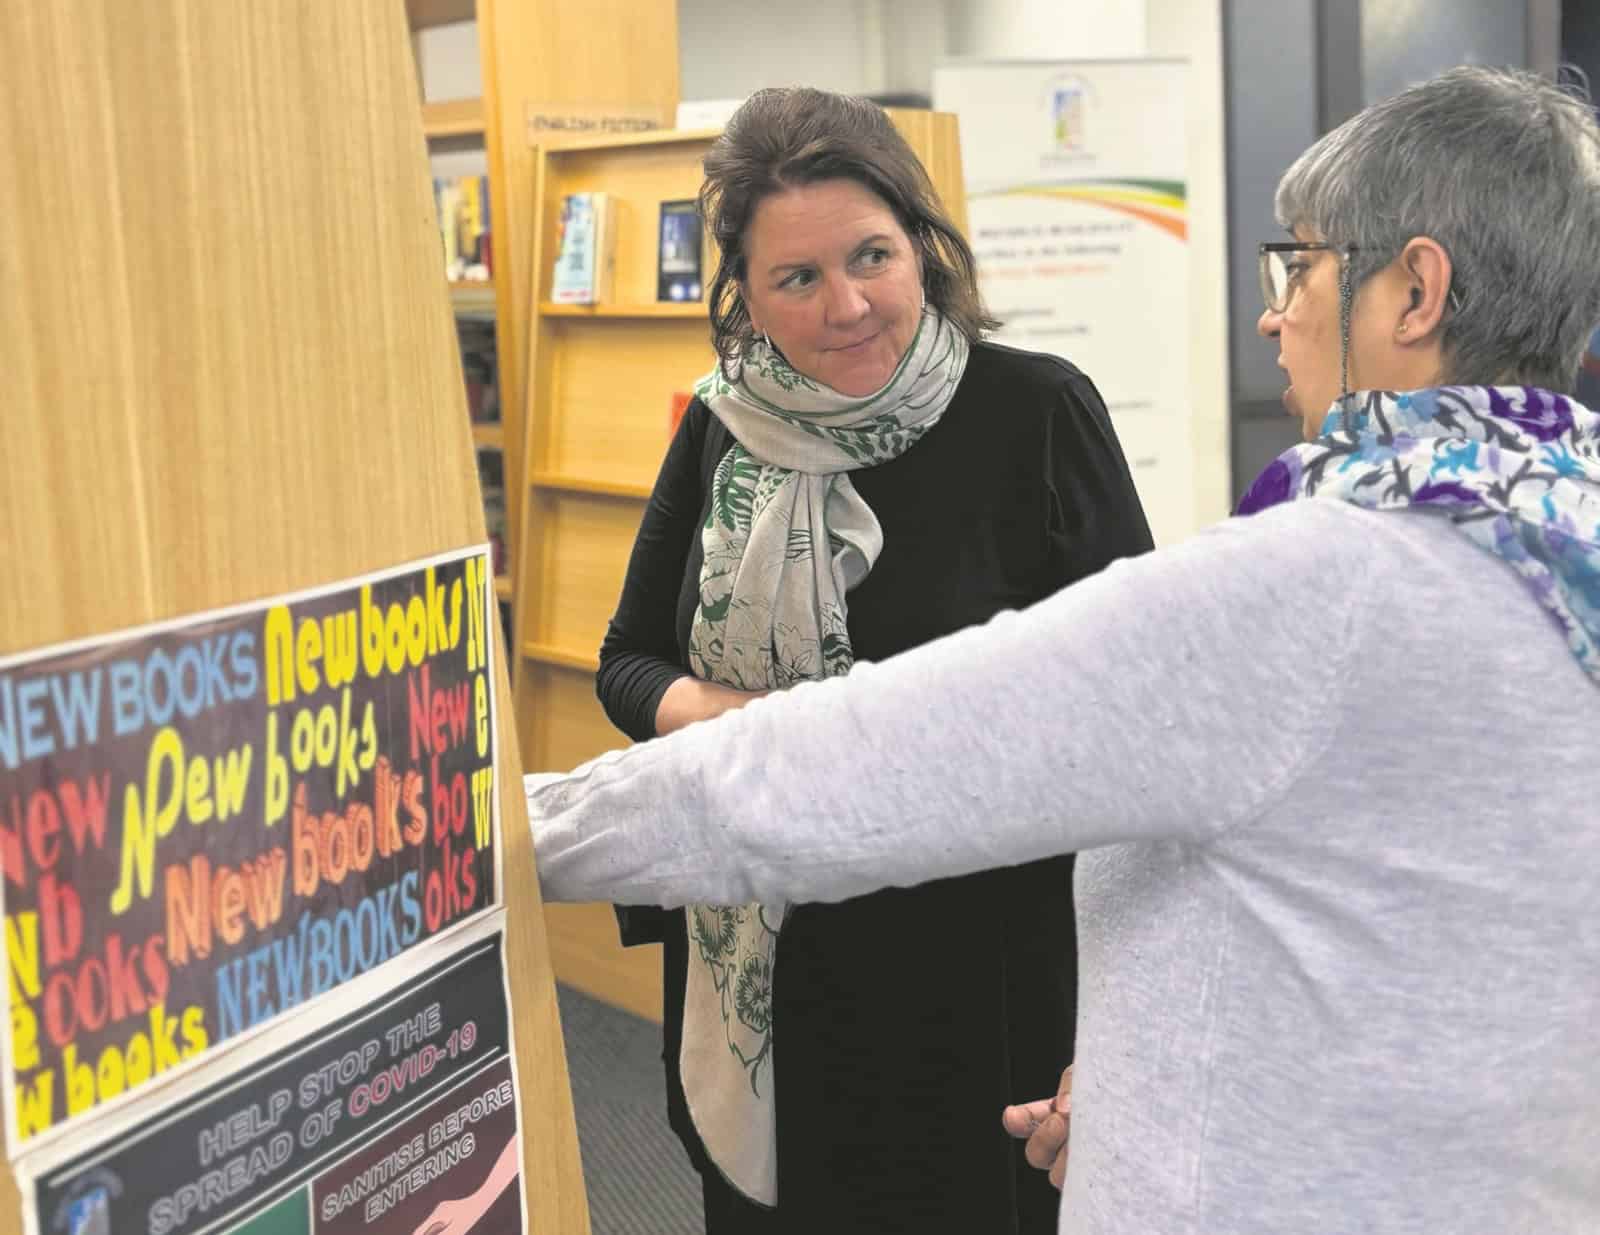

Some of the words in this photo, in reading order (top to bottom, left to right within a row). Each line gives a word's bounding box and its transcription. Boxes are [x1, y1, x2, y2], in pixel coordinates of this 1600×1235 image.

[110, 632, 258, 737] BOOKS
[361, 564, 463, 679] books
[264, 686, 378, 828] books
[408, 663, 470, 761] New
[164, 846, 287, 966] New
[292, 755, 427, 896] books
[62, 1001, 210, 1119] books
[199, 1088, 294, 1166] HELP
[298, 1039, 380, 1108] STOP
[385, 1002, 442, 1057] THE
[148, 1132, 295, 1235] SPREAD
[300, 1102, 343, 1149] OF
[348, 1021, 477, 1118] COVID-19
[321, 1133, 425, 1223] SANITISE
[428, 1079, 513, 1151] BEFORE
[364, 1131, 477, 1224] ENTERING
